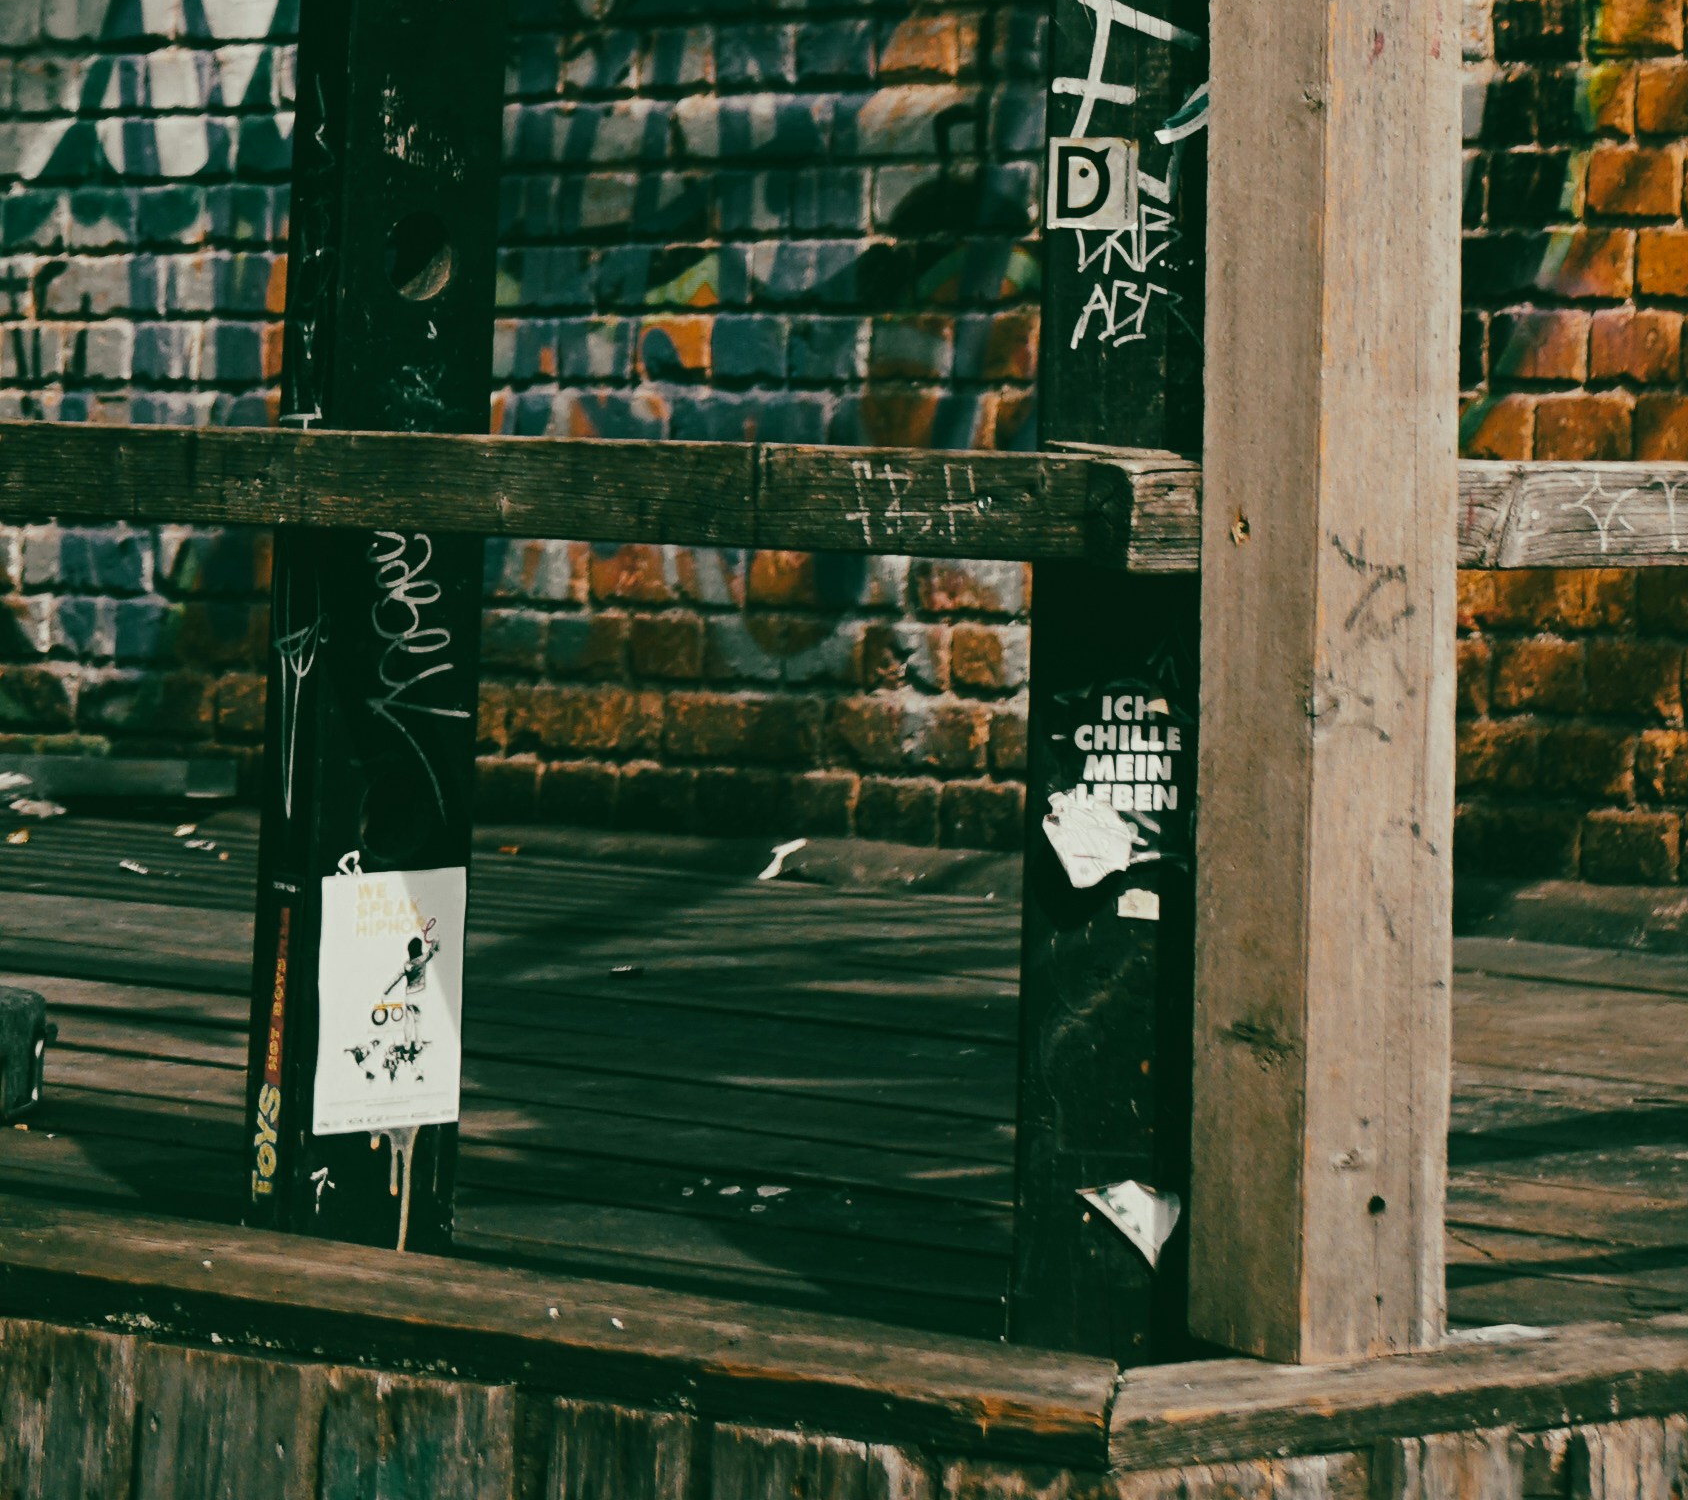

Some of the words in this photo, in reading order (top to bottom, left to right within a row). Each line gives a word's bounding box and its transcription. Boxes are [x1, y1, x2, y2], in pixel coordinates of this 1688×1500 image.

[1074, 725, 1182, 752] CHILLE
[1082, 755, 1172, 782] MEIN
[1075, 784, 1178, 812] LEBEN
[358, 882, 387, 898] WE
[252, 1083, 281, 1202] TOYS
